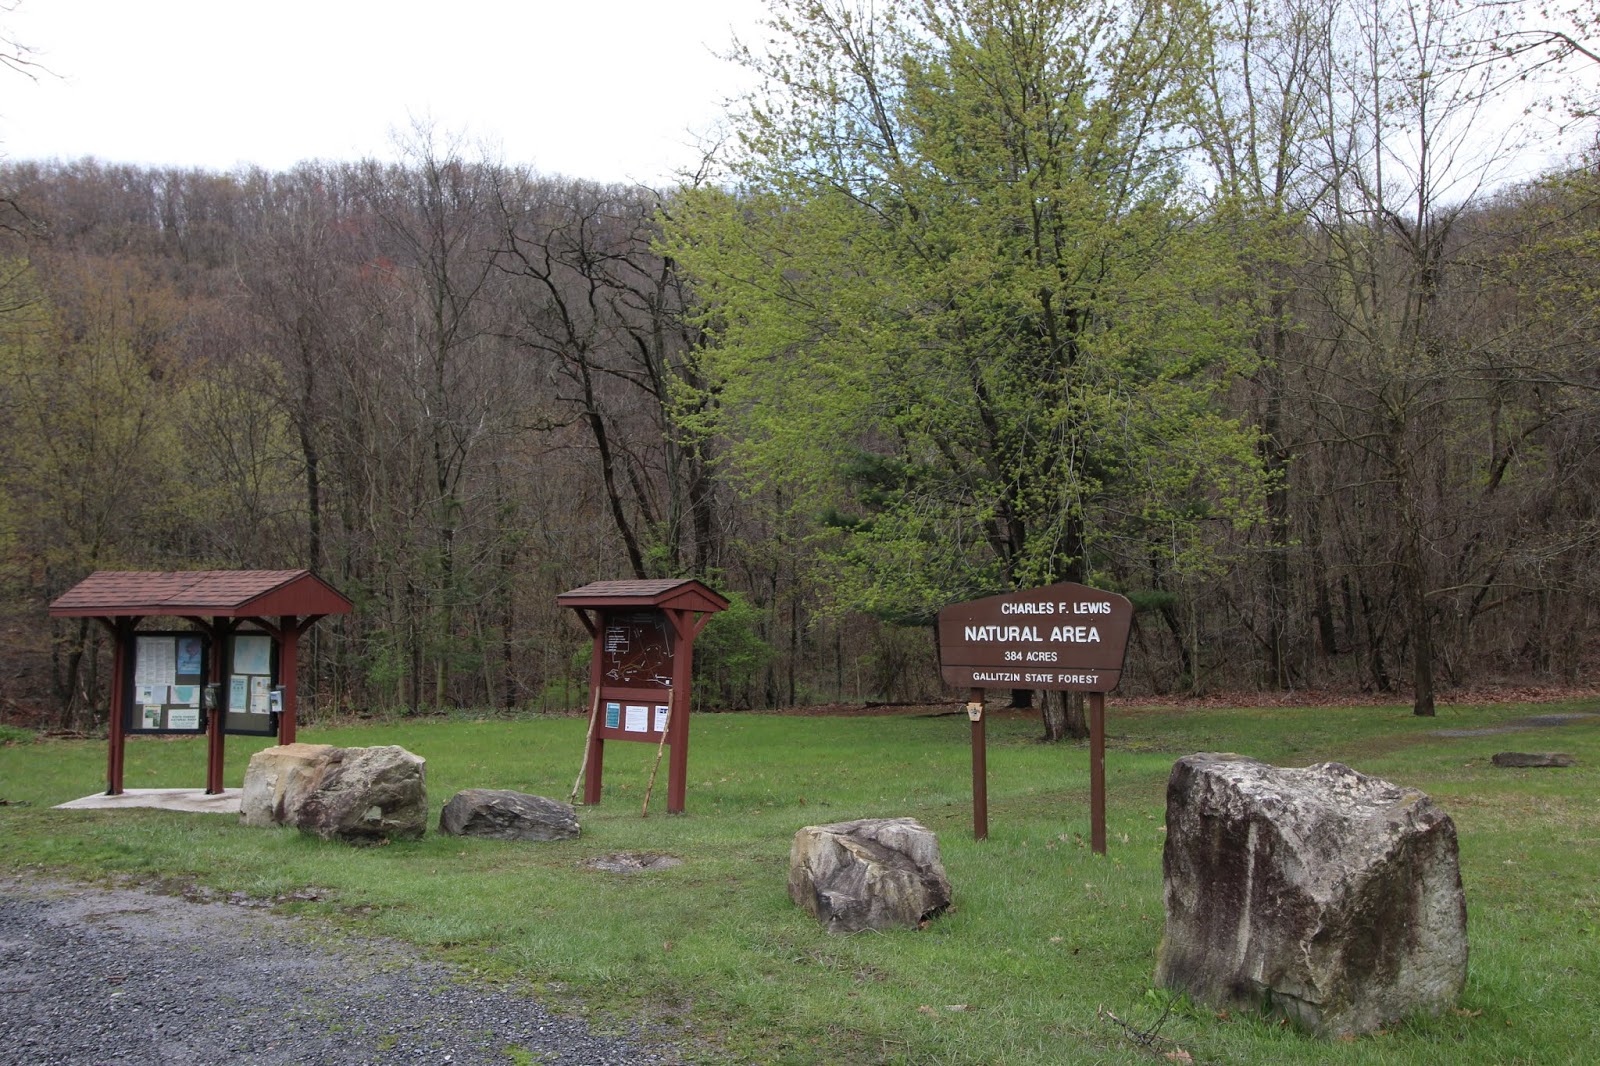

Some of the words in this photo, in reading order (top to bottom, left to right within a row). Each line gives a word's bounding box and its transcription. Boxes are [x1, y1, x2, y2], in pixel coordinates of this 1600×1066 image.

[1001, 602, 1054, 615] CHARLES
[1059, 602, 1069, 614] F.
[1073, 602, 1111, 614] LEWIS
[964, 626, 1043, 642] NATURAL
[1050, 626, 1100, 643] AREA
[1004, 651, 1022, 661] 384
[1026, 651, 1058, 662] ACRES
[973, 672, 1020, 682] GALLITZIN
[1025, 673, 1053, 683] STATE
[1058, 674, 1099, 684] FOREST
